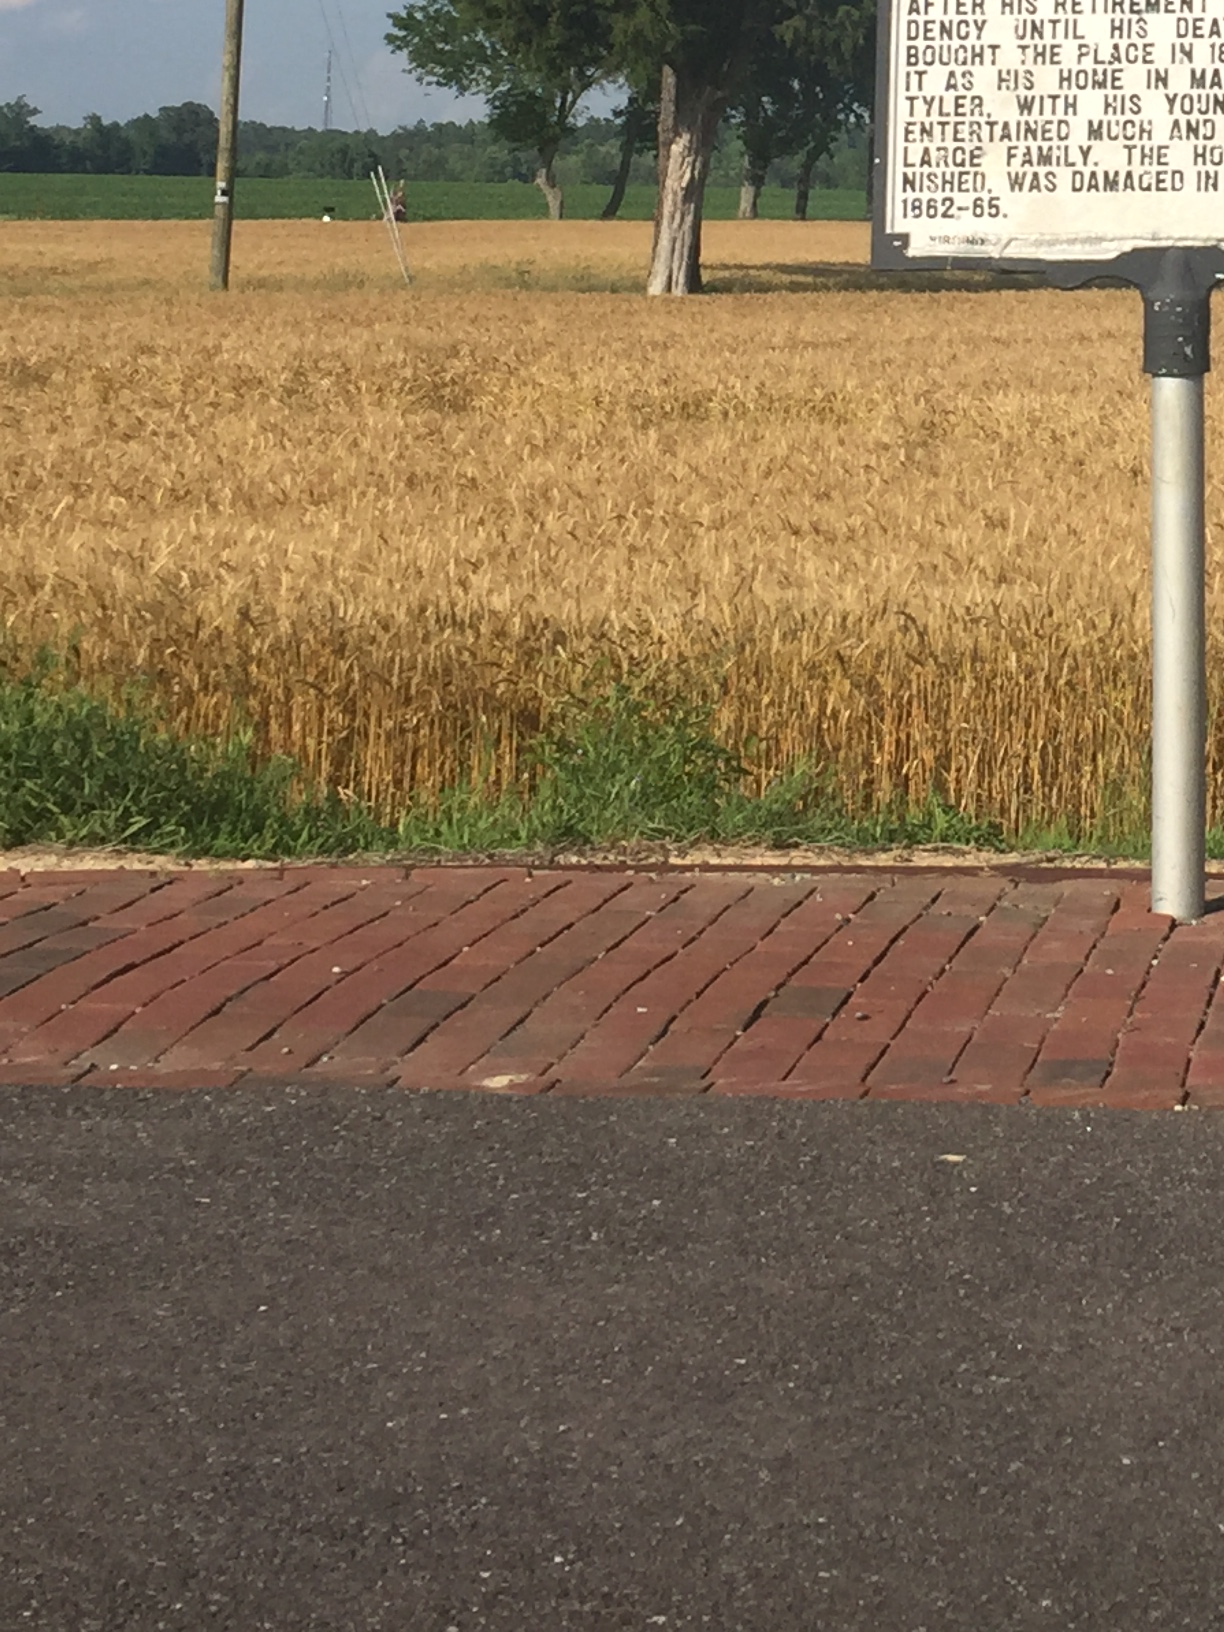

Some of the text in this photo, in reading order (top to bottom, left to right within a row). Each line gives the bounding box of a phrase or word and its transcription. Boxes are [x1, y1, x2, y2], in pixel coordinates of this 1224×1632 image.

[906, 18, 988, 42] DENCY
[1014, 19, 1086, 41] UNTIL
[1110, 17, 1148, 40] HIS
[906, 45, 1001, 67] BOUGHT
[1016, 44, 1063, 66] THE
[1077, 43, 1155, 66] PLACE
[1171, 43, 1194, 65] IN
[904, 71, 928, 92] IT
[944, 71, 974, 92] AS
[996, 70, 1035, 91] HIS
[1058, 68, 1124, 91] HOME
[1146, 69, 1169, 90] IN
[904, 95, 992, 119] TYLER,
[1015, 95, 1078, 117] WITH
[1103, 94, 1142, 116] HIS
[903, 120, 1070, 143] ENTERTAINED
[1087, 120, 1153, 142] MUCH
[1168, 119, 1216, 141] AND
[903, 146, 984, 169] LARGE
[1006, 145, 1099, 168] FAMILY.
[1122, 145, 1170, 166] THE
[902, 171, 993, 195] NISHED,
[1006, 171, 1057, 193] WAS
[1071, 170, 1184, 193] DAMAGED
[1196, 171, 1219, 192] IN
[901, 197, 1008, 219] 1862-65.
